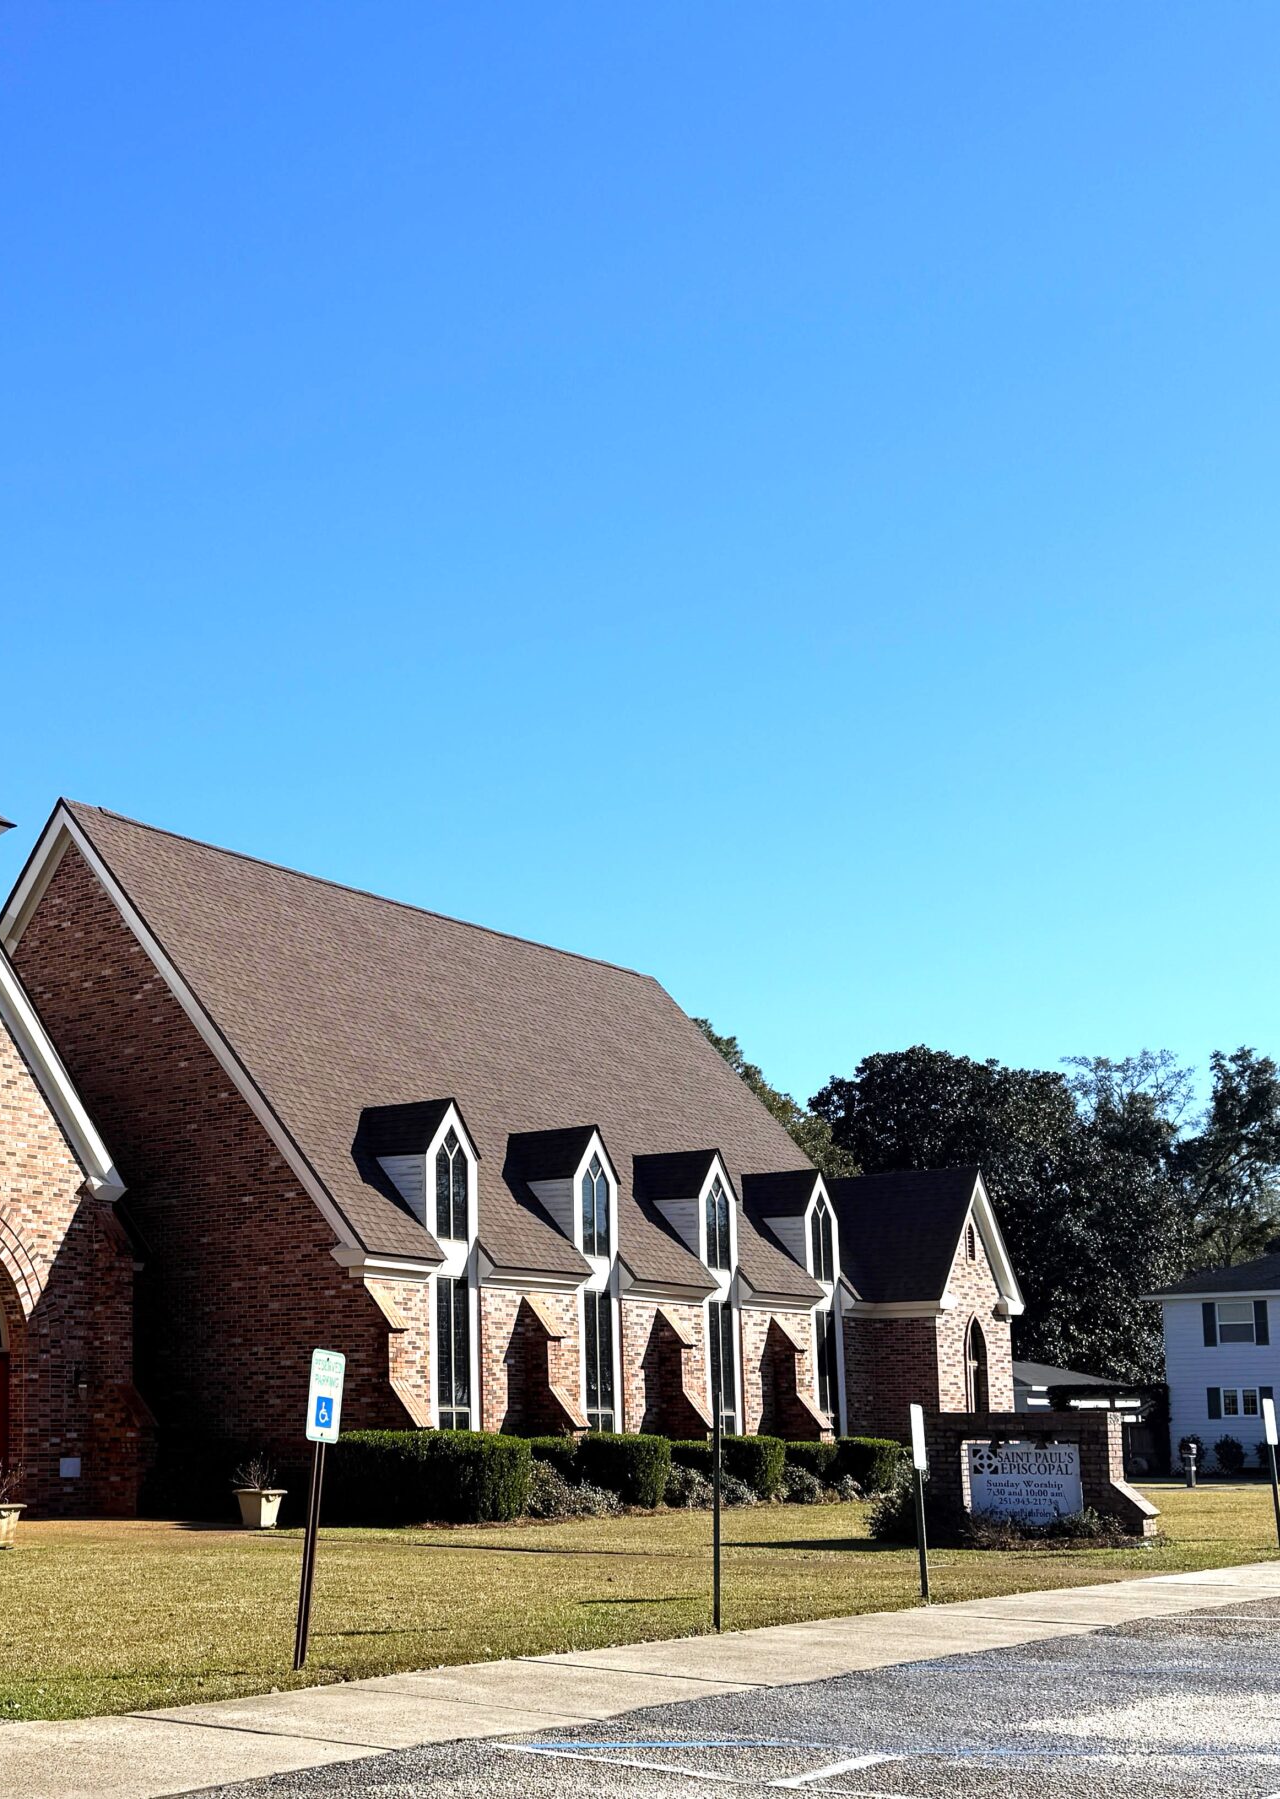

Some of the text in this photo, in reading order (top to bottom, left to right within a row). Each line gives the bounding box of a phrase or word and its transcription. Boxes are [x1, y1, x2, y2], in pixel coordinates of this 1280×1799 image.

[997, 1452, 1074, 1464] SAINT PAUL'S
[1001, 1463, 1073, 1475] EPISCOPAL
[986, 1480, 1063, 1491] Sunday Worship
[1025, 1489, 1049, 1497] 10:00
